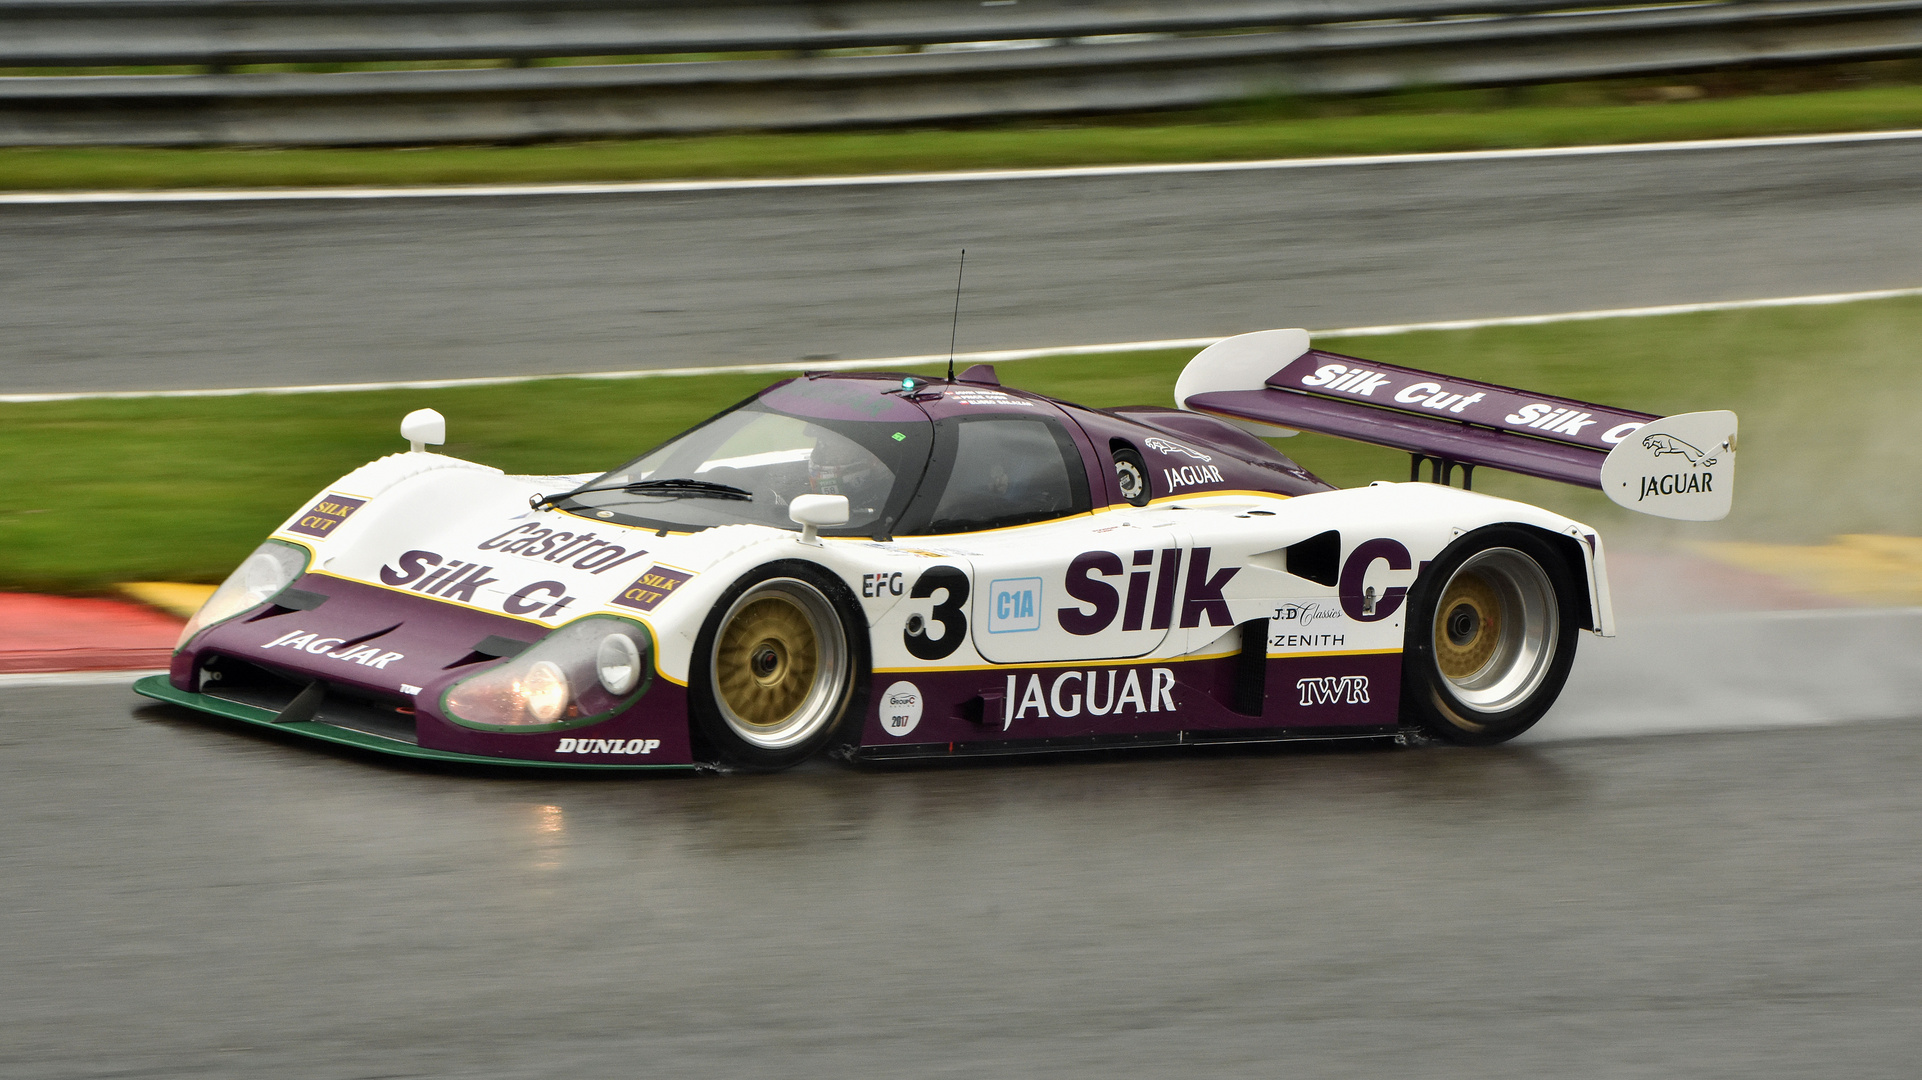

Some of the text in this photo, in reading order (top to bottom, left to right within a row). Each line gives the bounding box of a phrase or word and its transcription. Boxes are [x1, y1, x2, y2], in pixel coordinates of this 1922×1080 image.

[1301, 364, 1391, 396] Silk
[1394, 382, 1486, 413] Cut
[1504, 403, 1597, 436] Silk
[1163, 465, 1224, 493] JAGUAR
[1638, 472, 1713, 501] JAGUAR
[300, 515, 337, 531] CUT
[313, 501, 355, 517] SILK
[477, 521, 649, 575] Castrol
[380, 550, 499, 602] Silk
[638, 573, 681, 591] SILK
[862, 572, 903, 598] EFG
[1057, 537, 1432, 636] Silk C
[625, 588, 662, 604] CUT
[997, 590, 1034, 619] C1A
[903, 565, 970, 660] 3
[1299, 601, 1342, 627] Classics
[1274, 634, 1344, 647] ZENITH
[1003, 667, 1177, 731] JAGUAR
[1297, 675, 1370, 706] TWR
[891, 715, 909, 728] 2017
[555, 738, 660, 755] DUNLOP
